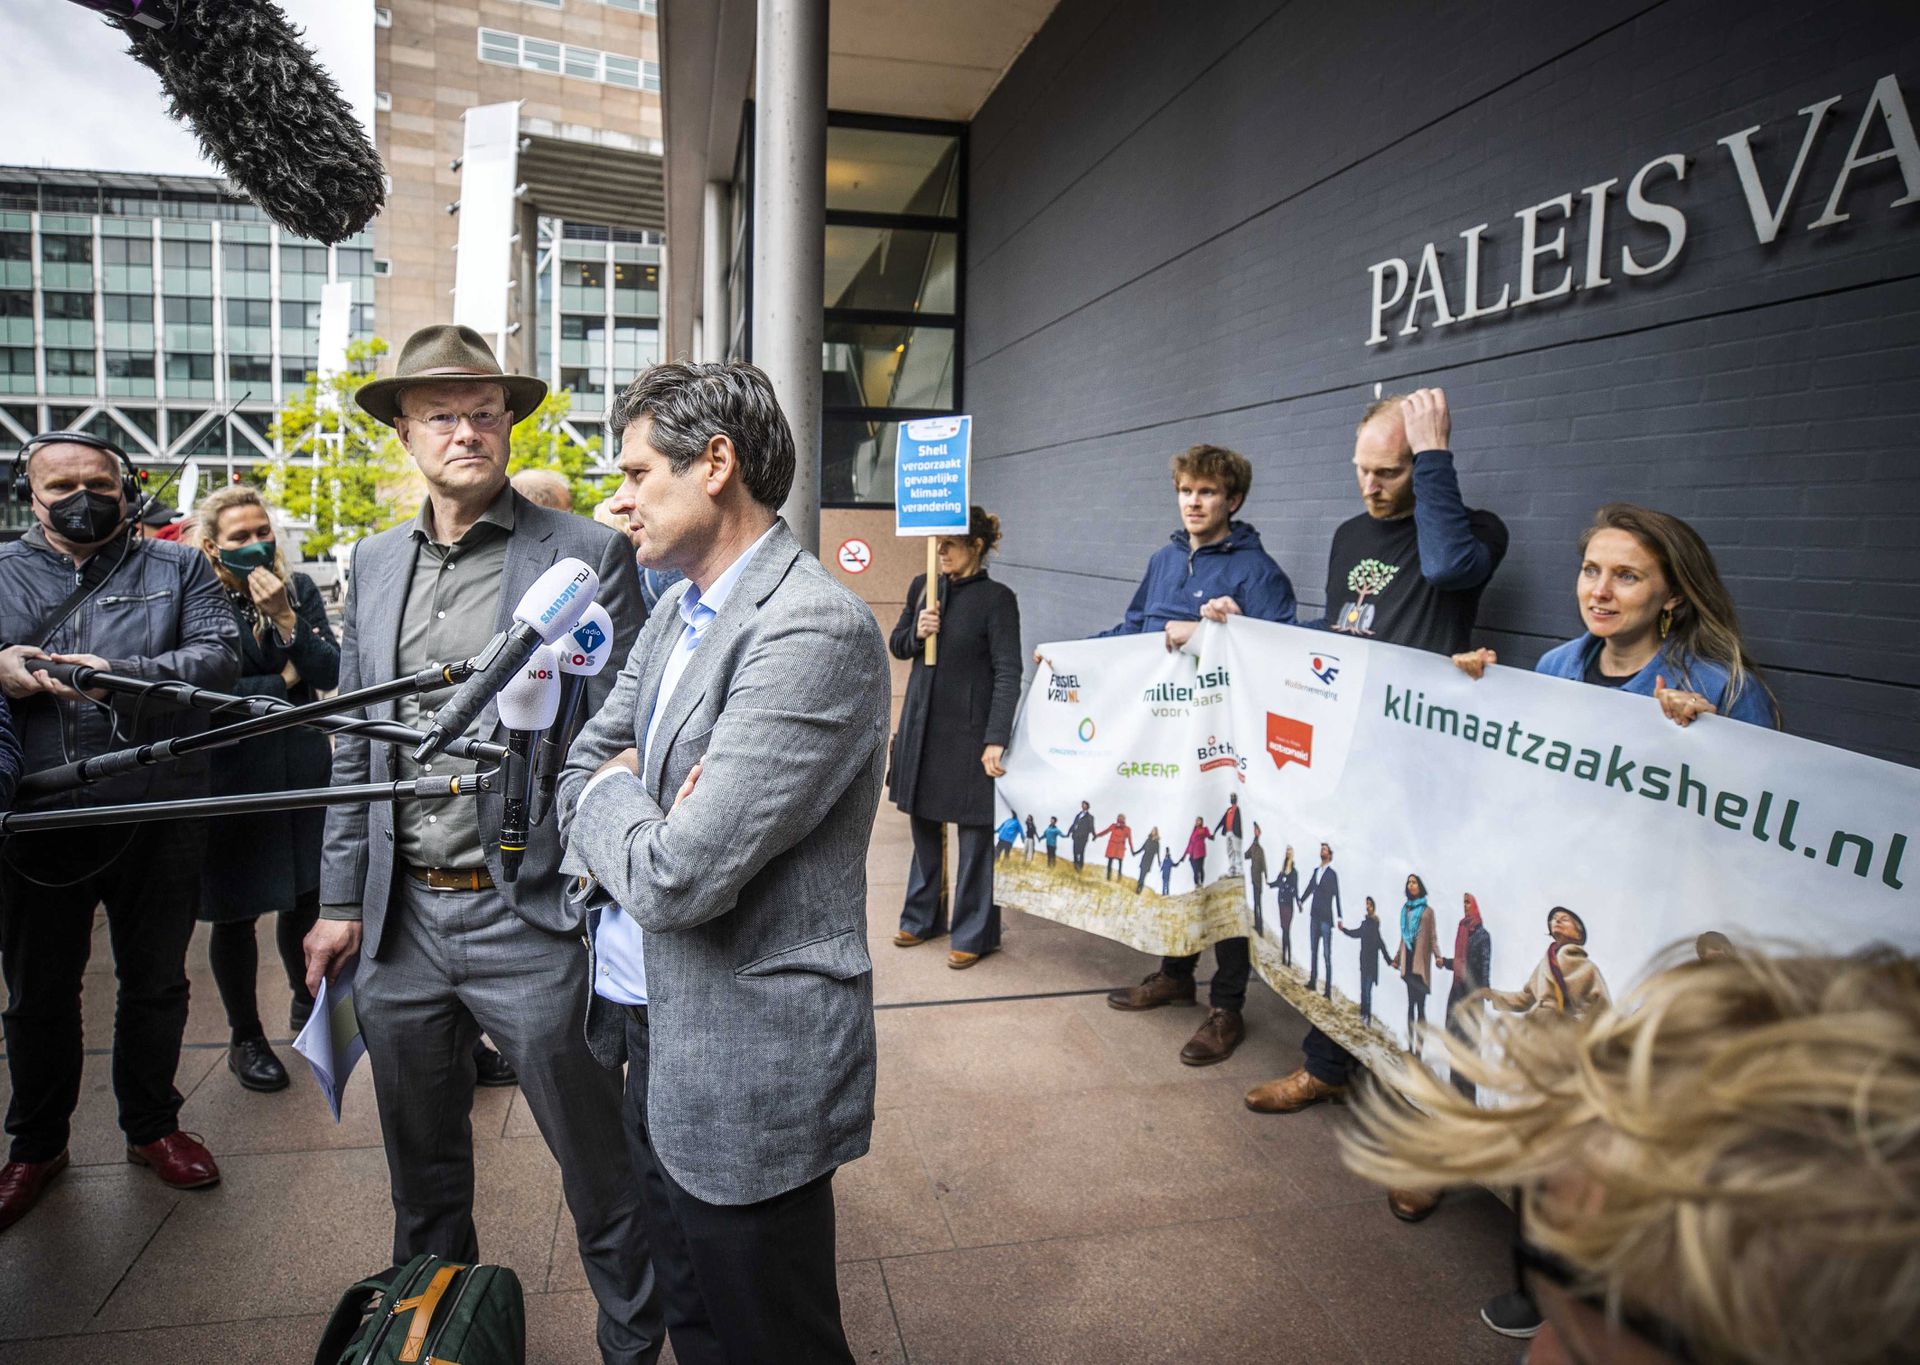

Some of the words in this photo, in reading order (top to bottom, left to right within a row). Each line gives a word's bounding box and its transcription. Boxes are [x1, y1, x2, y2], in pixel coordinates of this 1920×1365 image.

[1364, 152, 1689, 346] PALEIS
[1716, 72, 1920, 245] VA
[918, 444, 948, 457] Shell
[902, 459, 961, 472] veroorzaakt
[904, 473, 959, 487] gevaarlijke
[910, 488, 952, 499] klimaat-
[902, 501, 962, 514] verandering
[540, 581, 579, 624] nieuws
[582, 628, 601, 636] radio
[560, 650, 596, 667] NOS
[528, 669, 553, 680] NOS
[1383, 684, 1908, 891] klimaatzaakshell.nl
